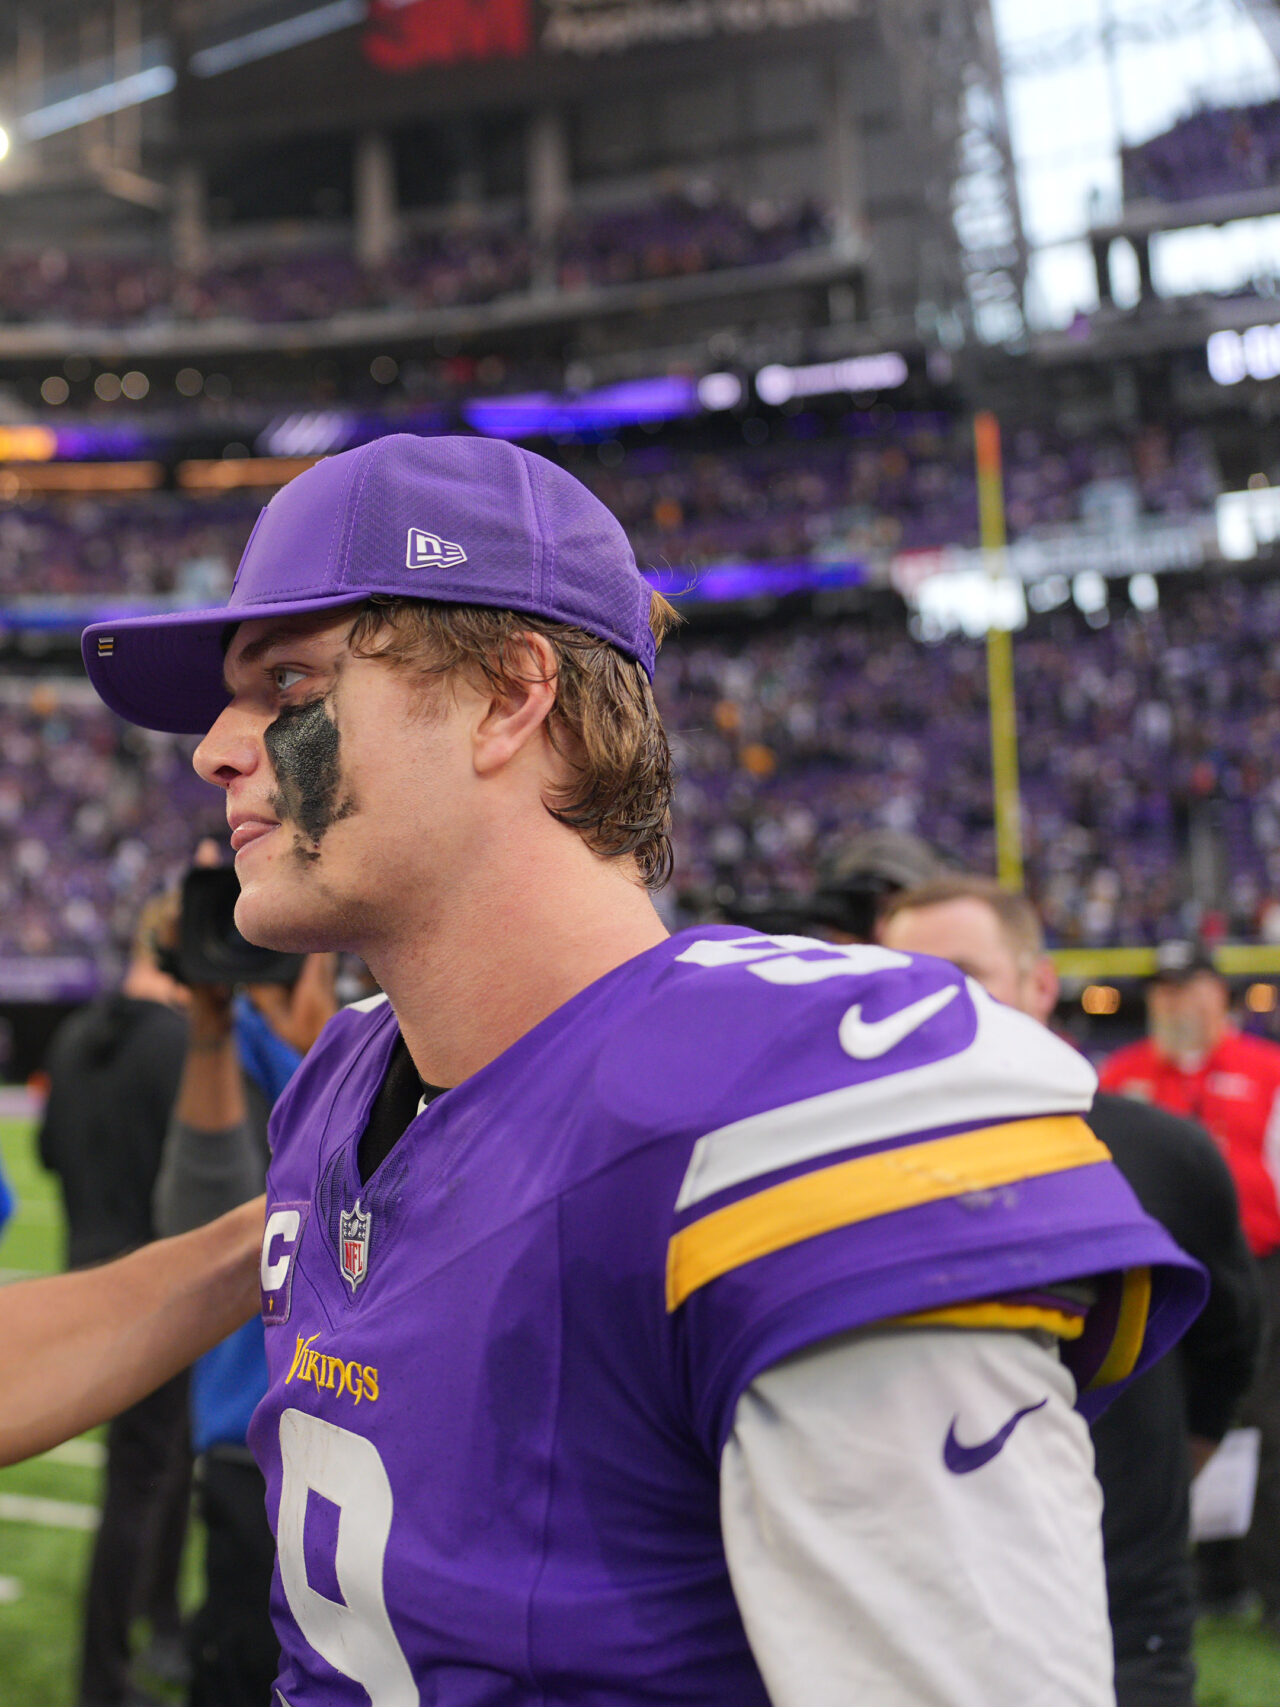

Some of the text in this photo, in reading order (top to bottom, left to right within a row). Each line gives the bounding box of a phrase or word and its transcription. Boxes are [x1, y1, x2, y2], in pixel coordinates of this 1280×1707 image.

[261, 1210, 300, 1291] C
[344, 1241, 363, 1275] NFL
[276, 1407, 420, 1707] 9
